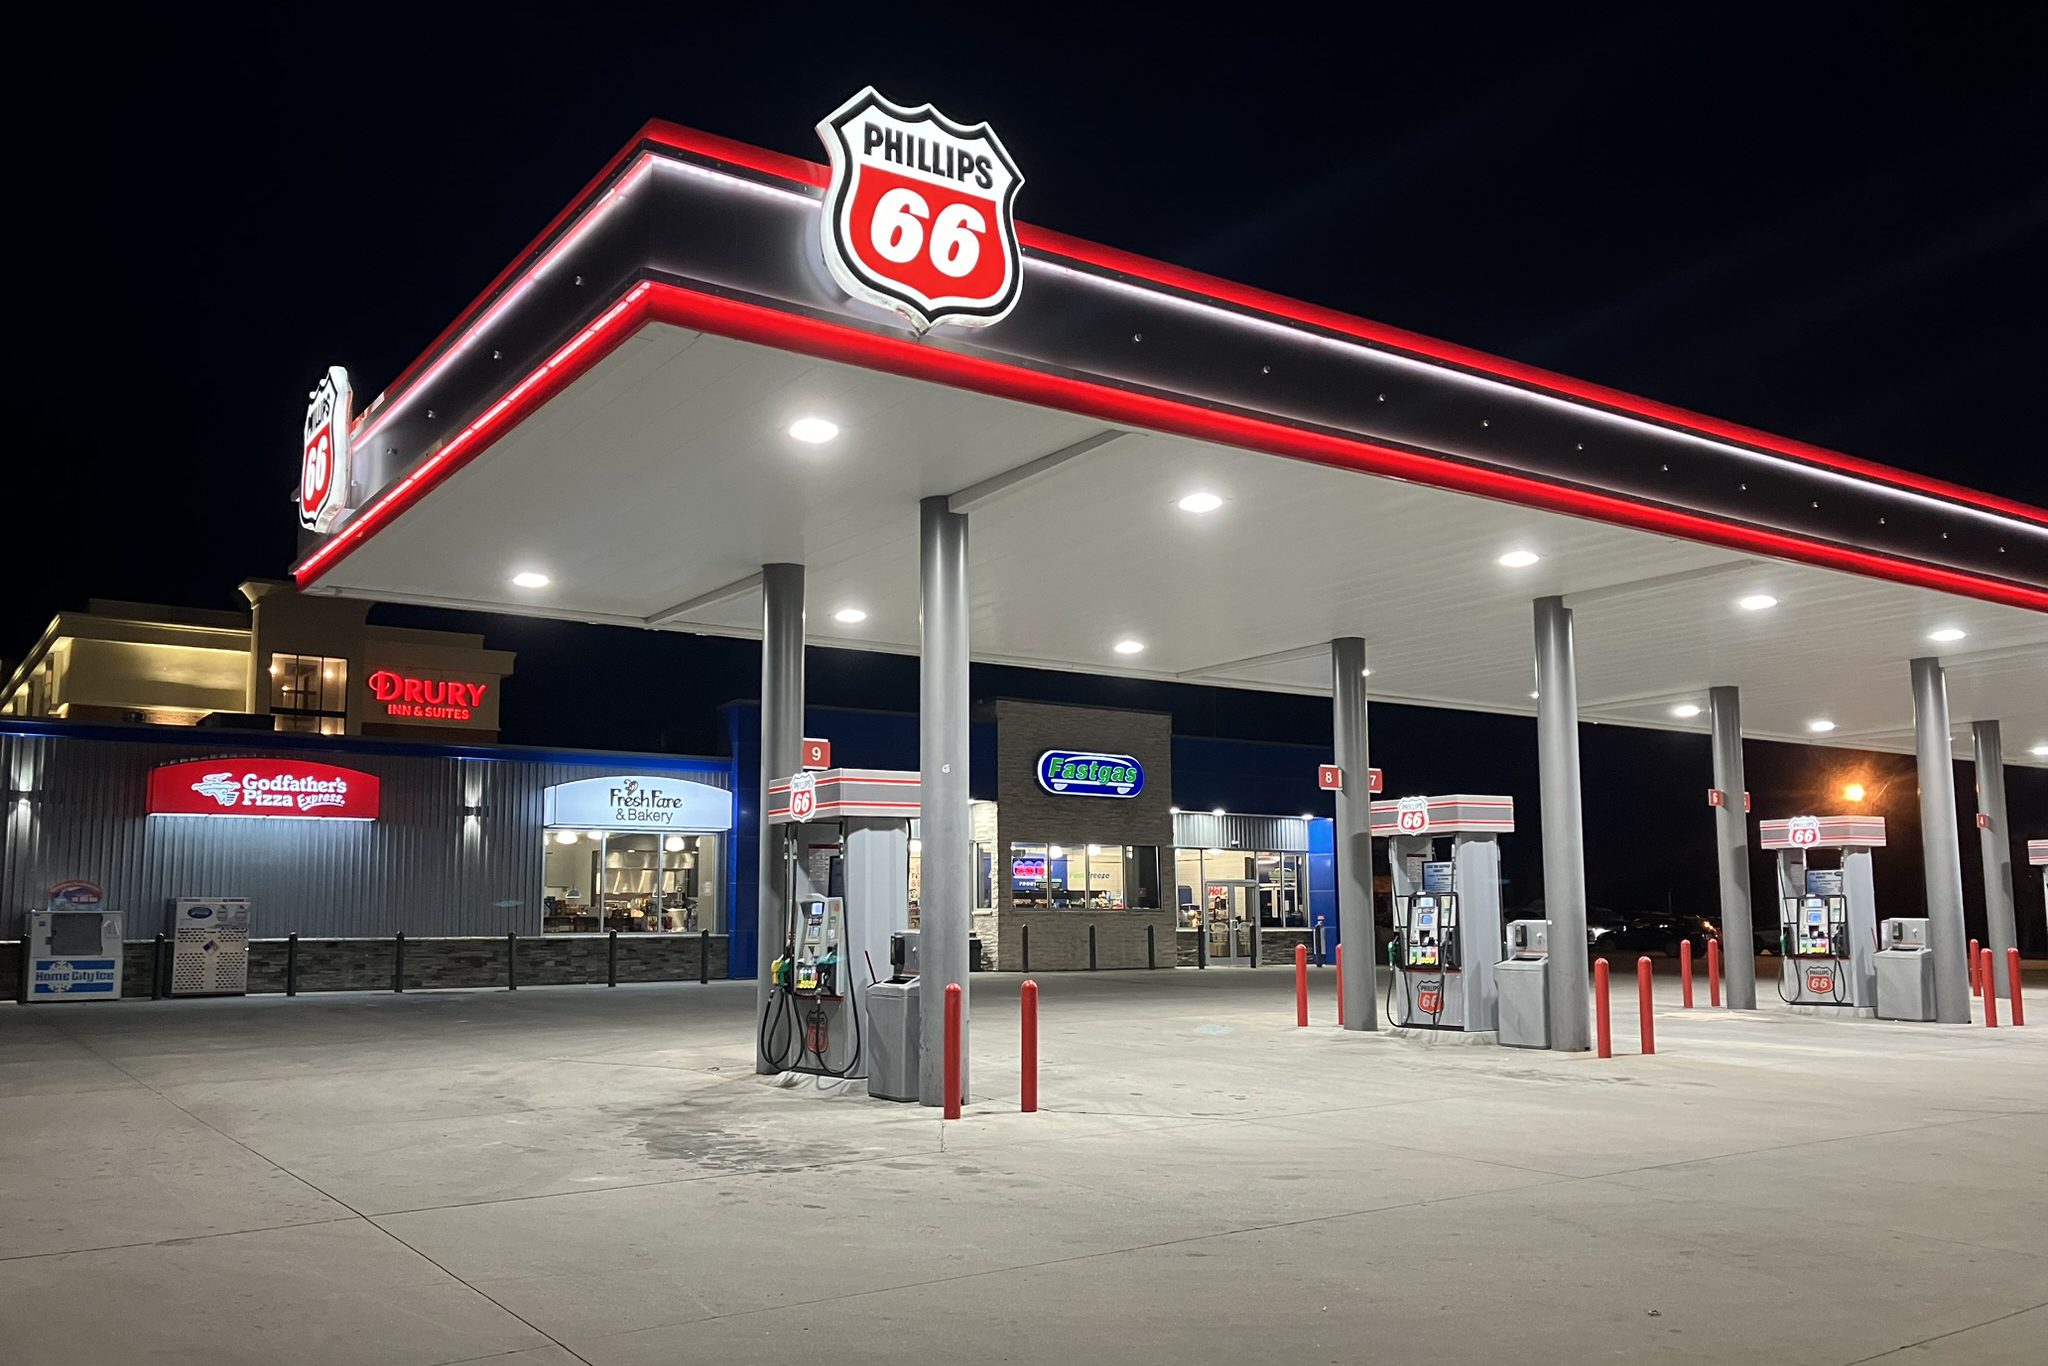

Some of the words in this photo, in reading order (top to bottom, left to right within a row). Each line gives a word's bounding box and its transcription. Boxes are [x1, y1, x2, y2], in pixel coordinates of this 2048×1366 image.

[863, 121, 994, 190] PHILLIPS
[870, 187, 987, 278] 66
[304, 434, 329, 501] 66
[368, 670, 487, 707] DRURY
[387, 704, 412, 716] INN
[413, 706, 423, 717] &
[424, 706, 470, 720] SUITES
[811, 746, 822, 761] 9
[1047, 757, 1138, 785] Fastgas
[1325, 771, 1333, 784] 8
[242, 773, 347, 793] Godfather's
[1369, 774, 1377, 786] 7
[242, 789, 293, 807] Pizza
[609, 788, 650, 808] Fresh
[651, 789, 683, 809] Fare
[793, 792, 810, 813] 66
[1402, 802, 1423, 811] PHILLIPS
[615, 808, 627, 821] &
[628, 808, 674, 825] Bakery
[1402, 812, 1423, 829] 66
[1794, 829, 1815, 843] 66
[35, 971, 70, 981] Home
[71, 971, 94, 983] City
[95, 970, 114, 980] Ice
[1811, 977, 1828, 989] 66
